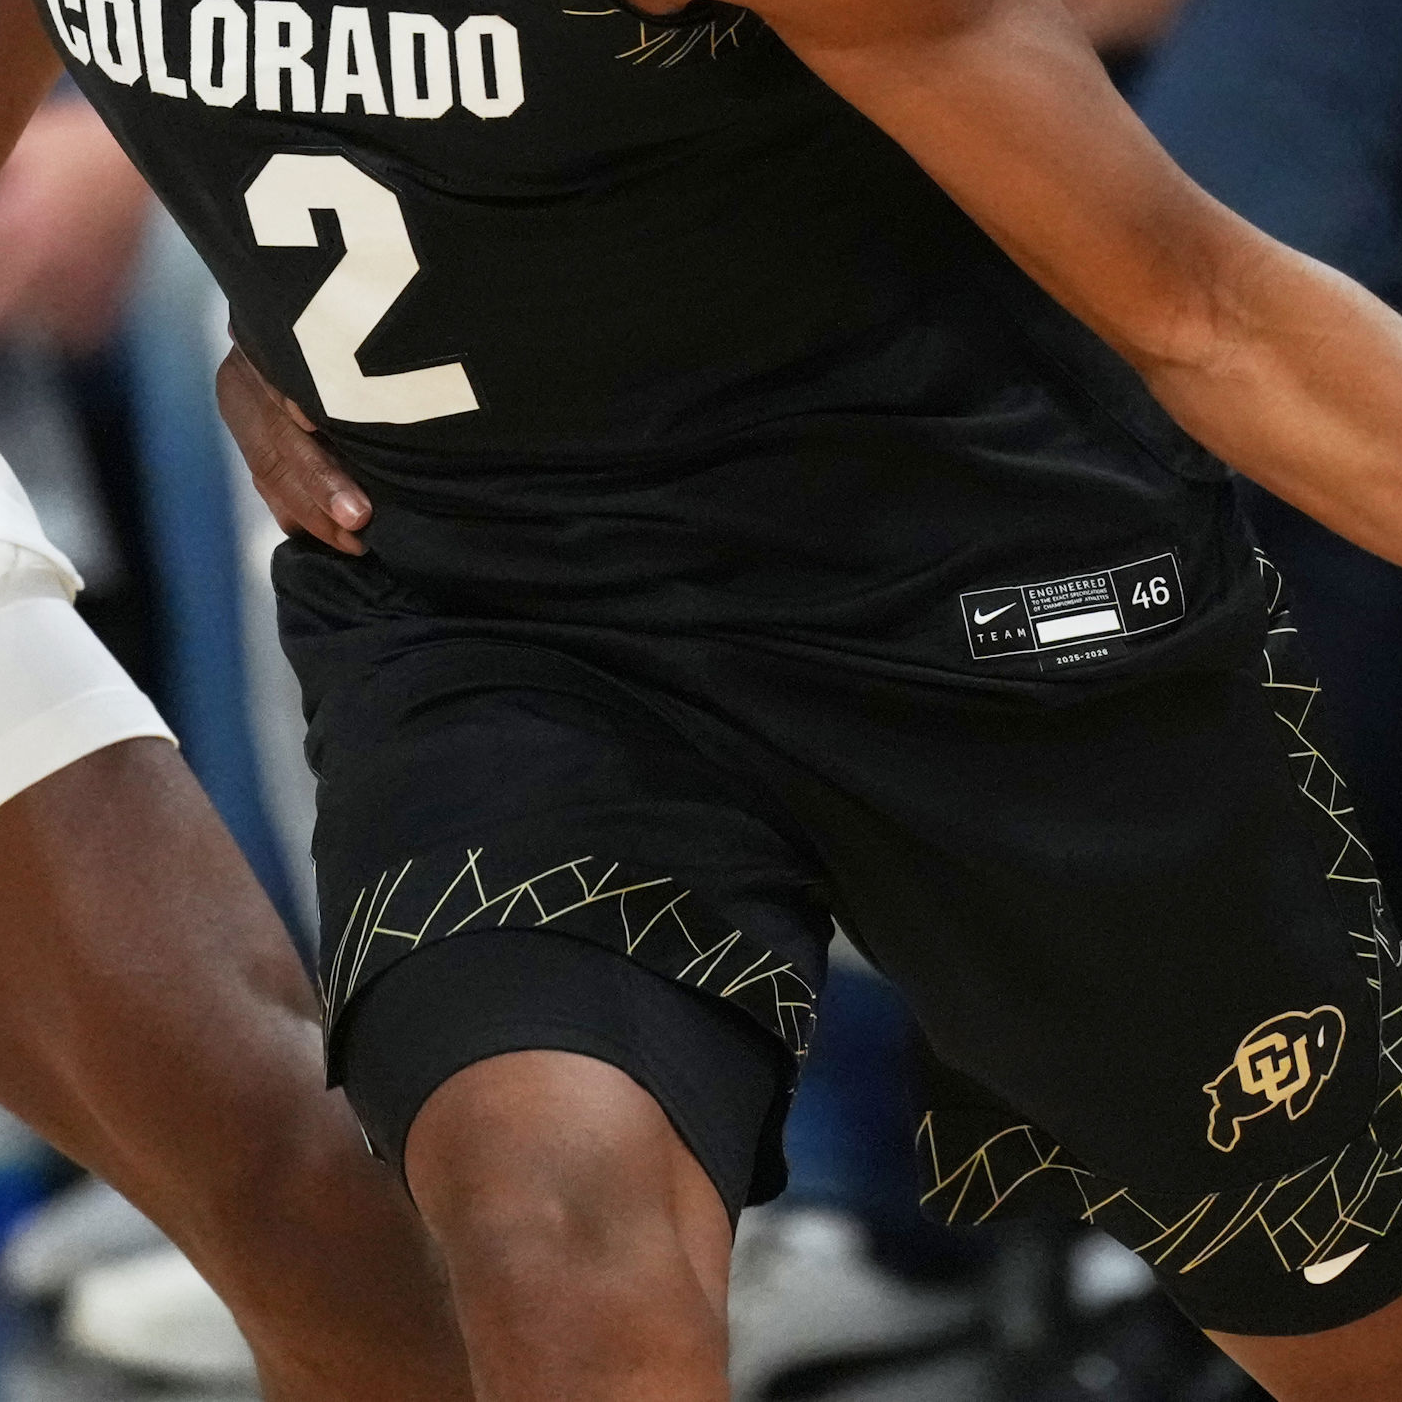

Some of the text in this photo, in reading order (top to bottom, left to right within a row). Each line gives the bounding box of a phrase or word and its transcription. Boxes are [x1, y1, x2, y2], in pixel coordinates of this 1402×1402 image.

[244, 153, 481, 424] 2
[1028, 577, 1107, 600] ENGINEERED
[1131, 576, 1171, 610] 46
[976, 628, 1027, 644] TEAM
[1056, 648, 1109, 665] 2025-2026
[1236, 1031, 1311, 1104] CU
